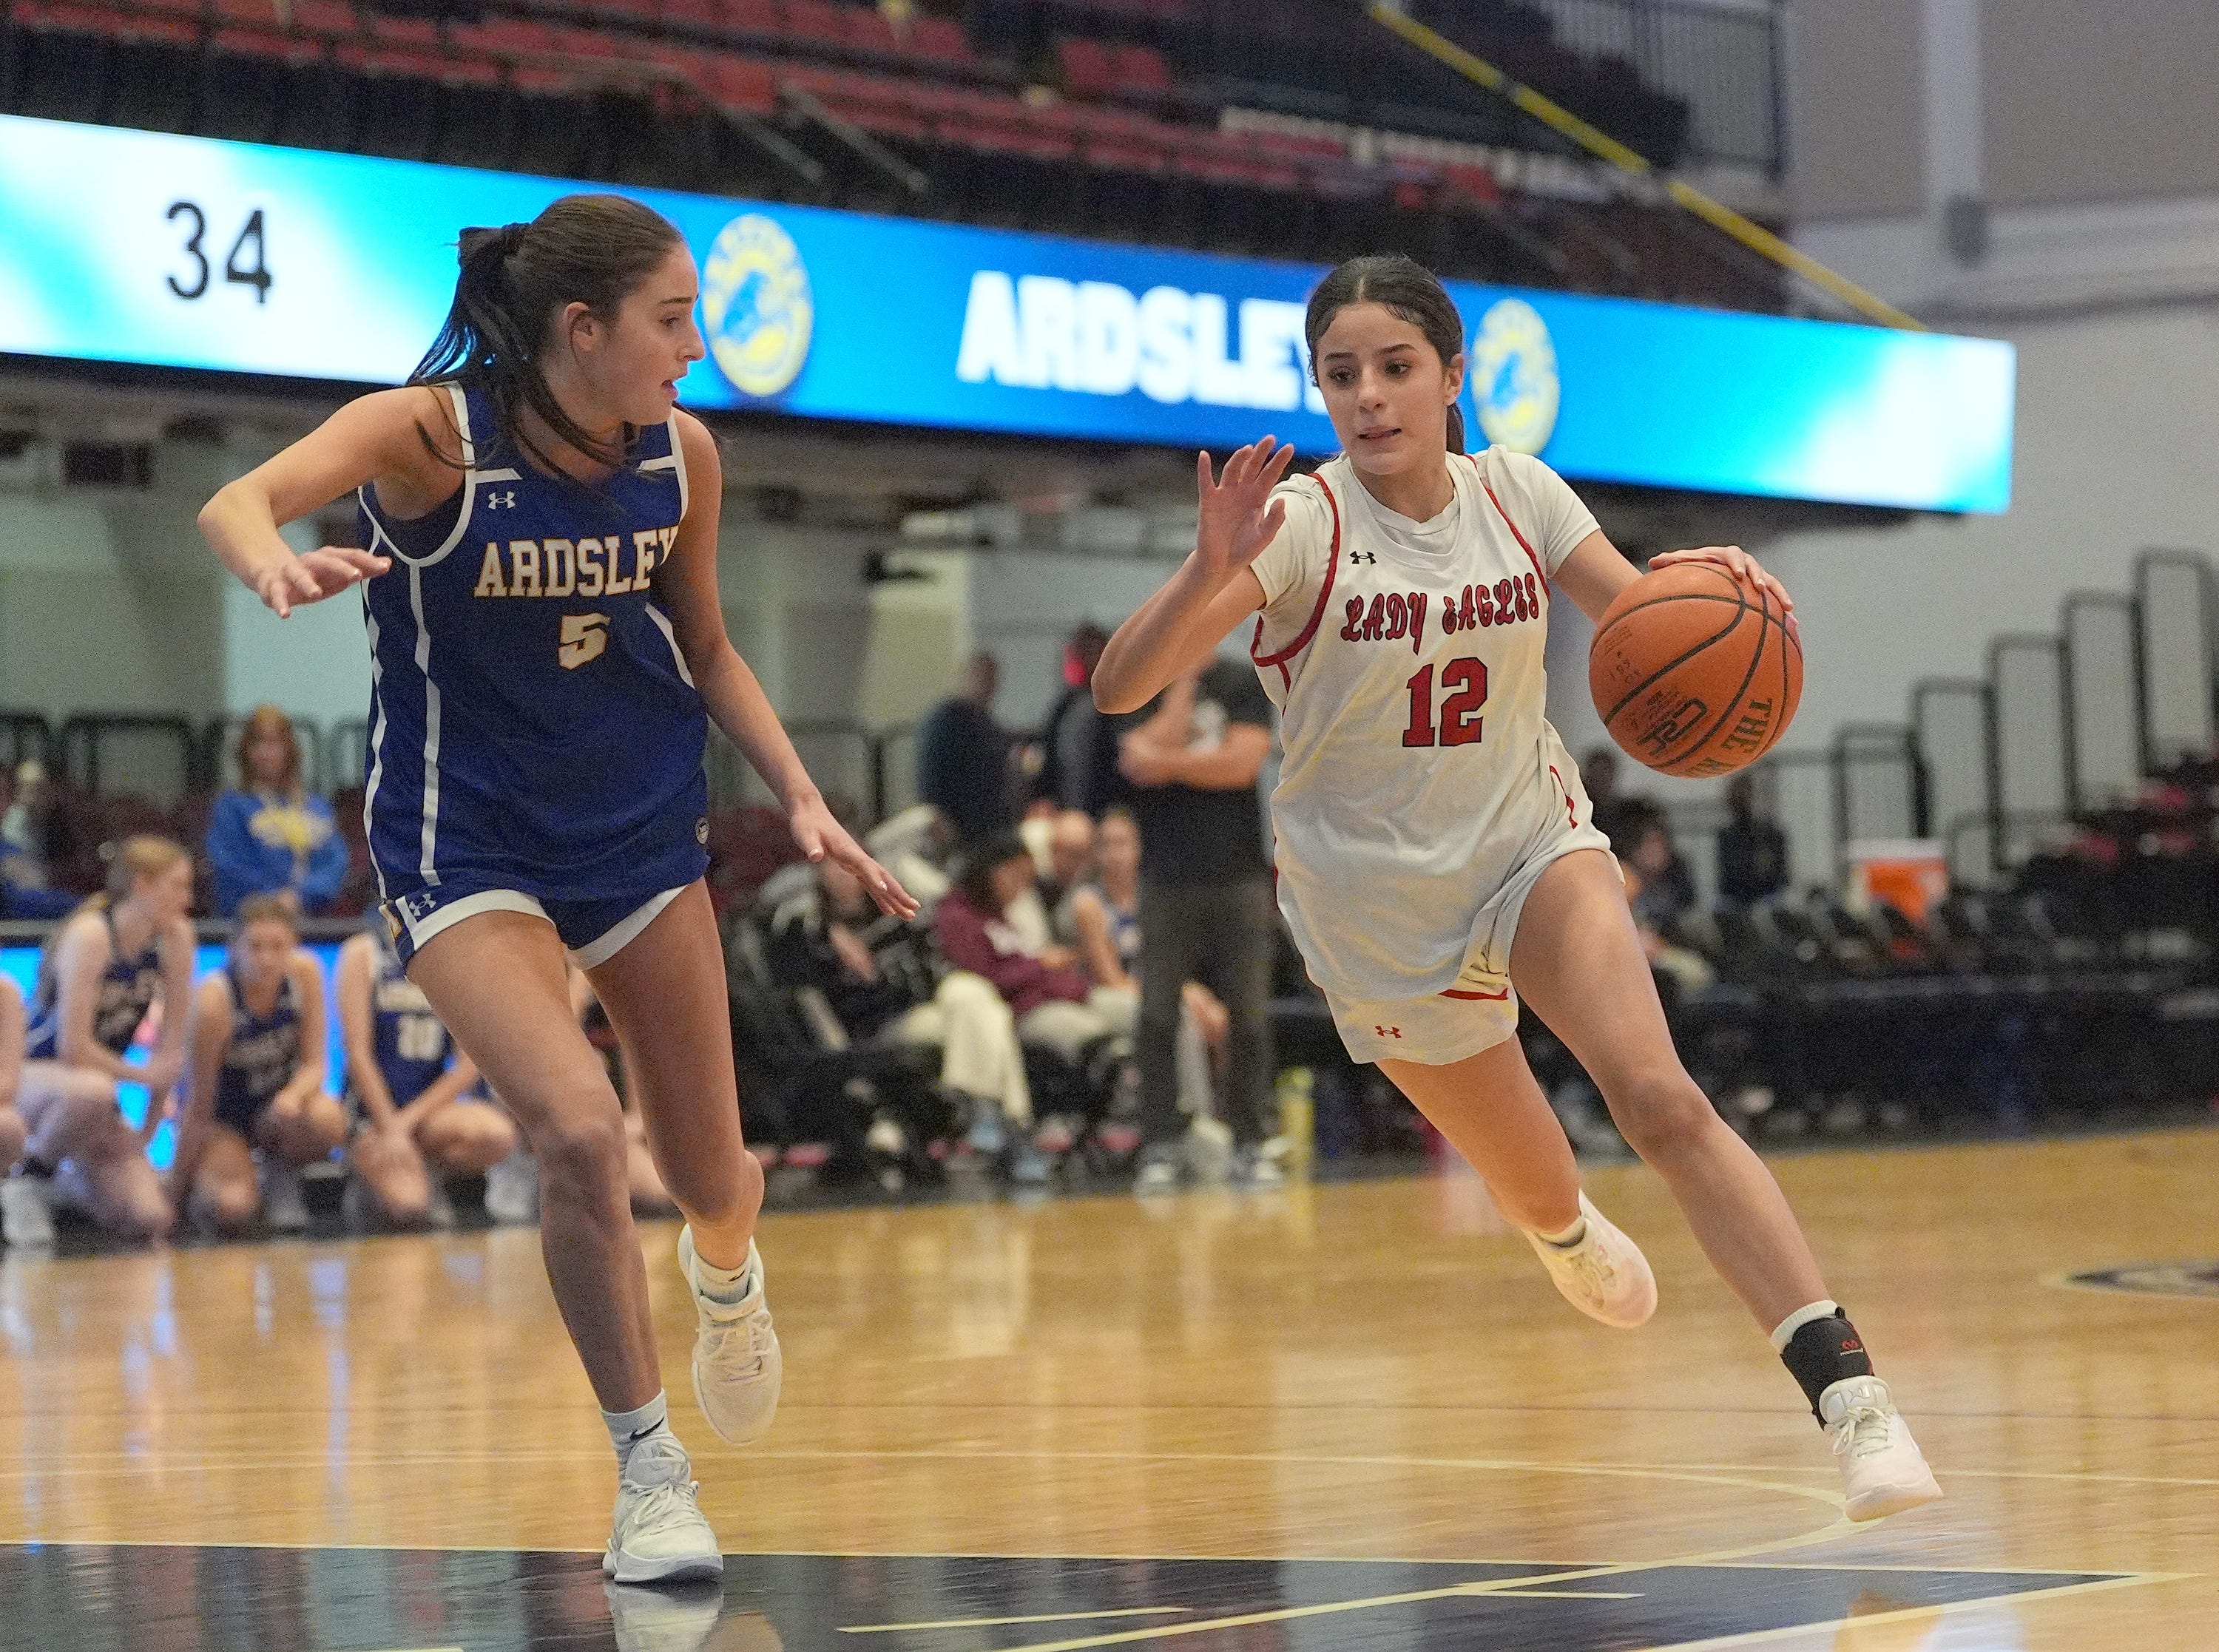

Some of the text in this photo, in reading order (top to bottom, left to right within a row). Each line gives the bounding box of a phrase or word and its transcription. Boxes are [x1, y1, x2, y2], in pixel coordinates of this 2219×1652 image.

[165, 201, 272, 304] 34
[558, 612, 612, 670] 5
[1340, 572, 1539, 656] LADY EAGLES
[1402, 657, 1487, 747] 12
[1721, 697, 1772, 754] THE
